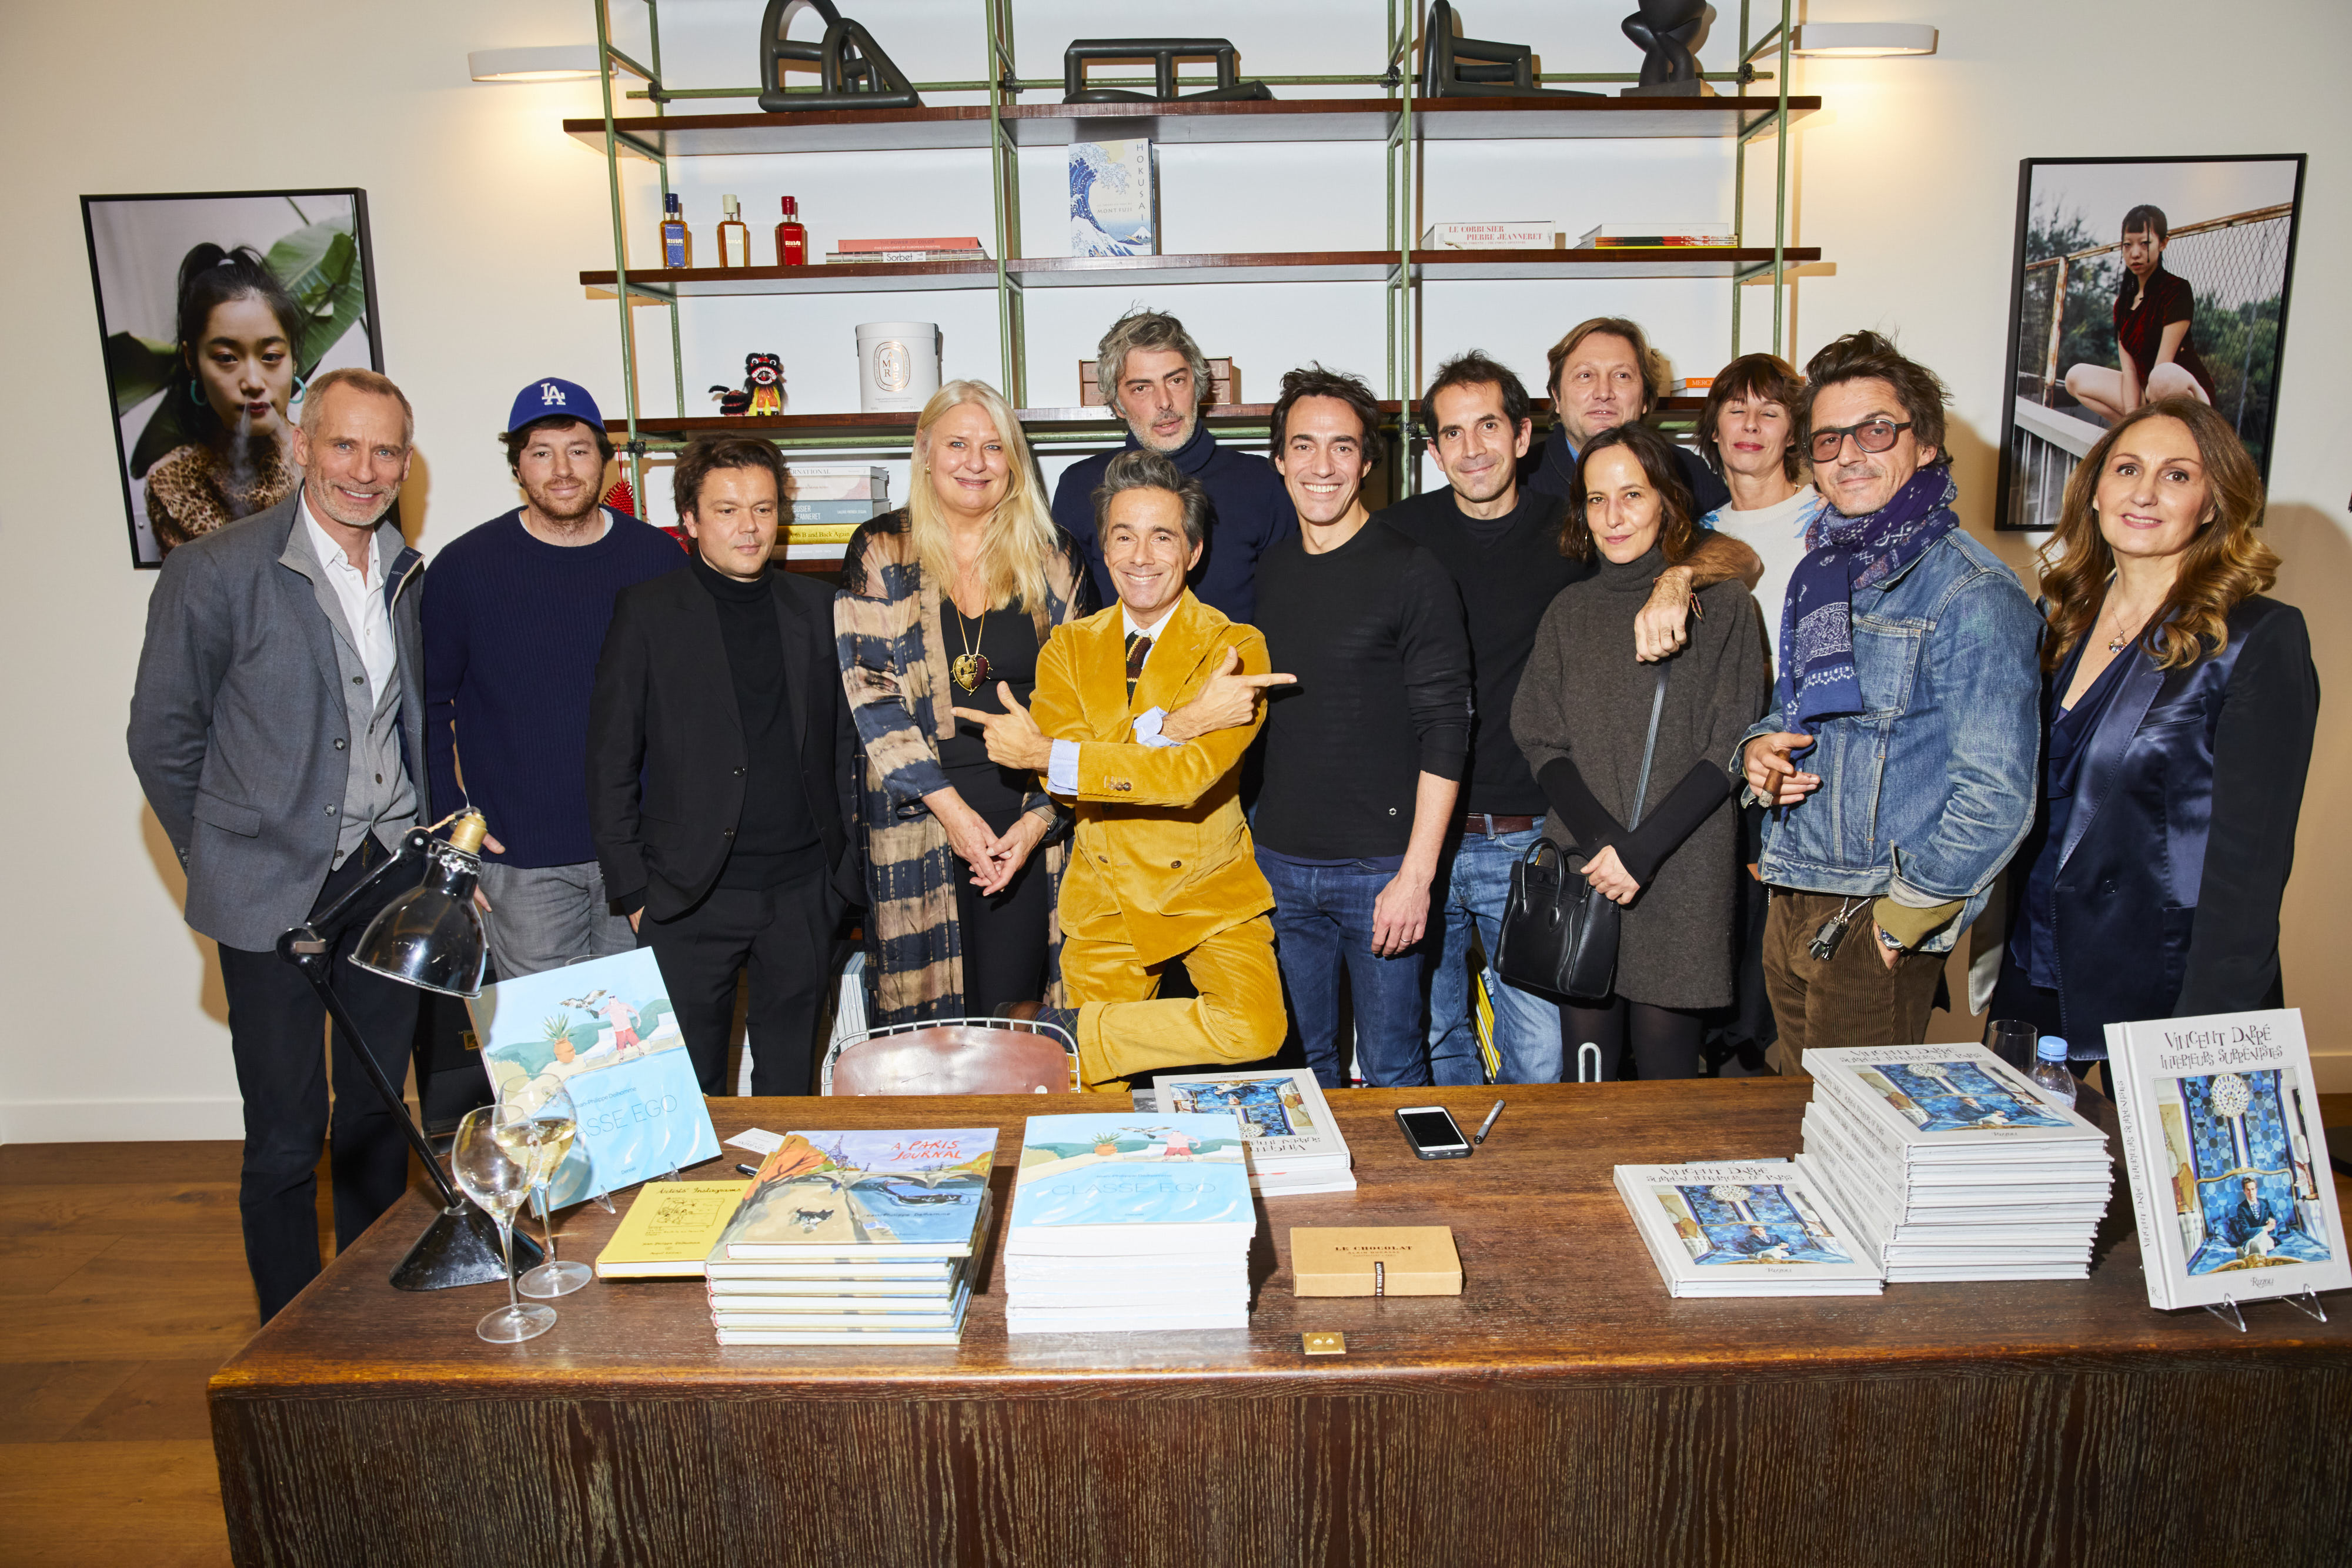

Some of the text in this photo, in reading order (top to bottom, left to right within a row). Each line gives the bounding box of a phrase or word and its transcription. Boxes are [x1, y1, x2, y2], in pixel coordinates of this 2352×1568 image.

[1137, 144, 1145, 221] HOKUSAI
[887, 253, 913, 262] Sorbet
[540, 383, 566, 406] LA
[2231, 1024, 2271, 1045] DARRÉ
[609, 1086, 637, 1099] Delhomme
[576, 1095, 677, 1141] ASSE EGO
[891, 1139, 960, 1151] A PARIS
[890, 1150, 962, 1161] JOURNAL
[1051, 1183, 1216, 1195] CLASSE EGO
